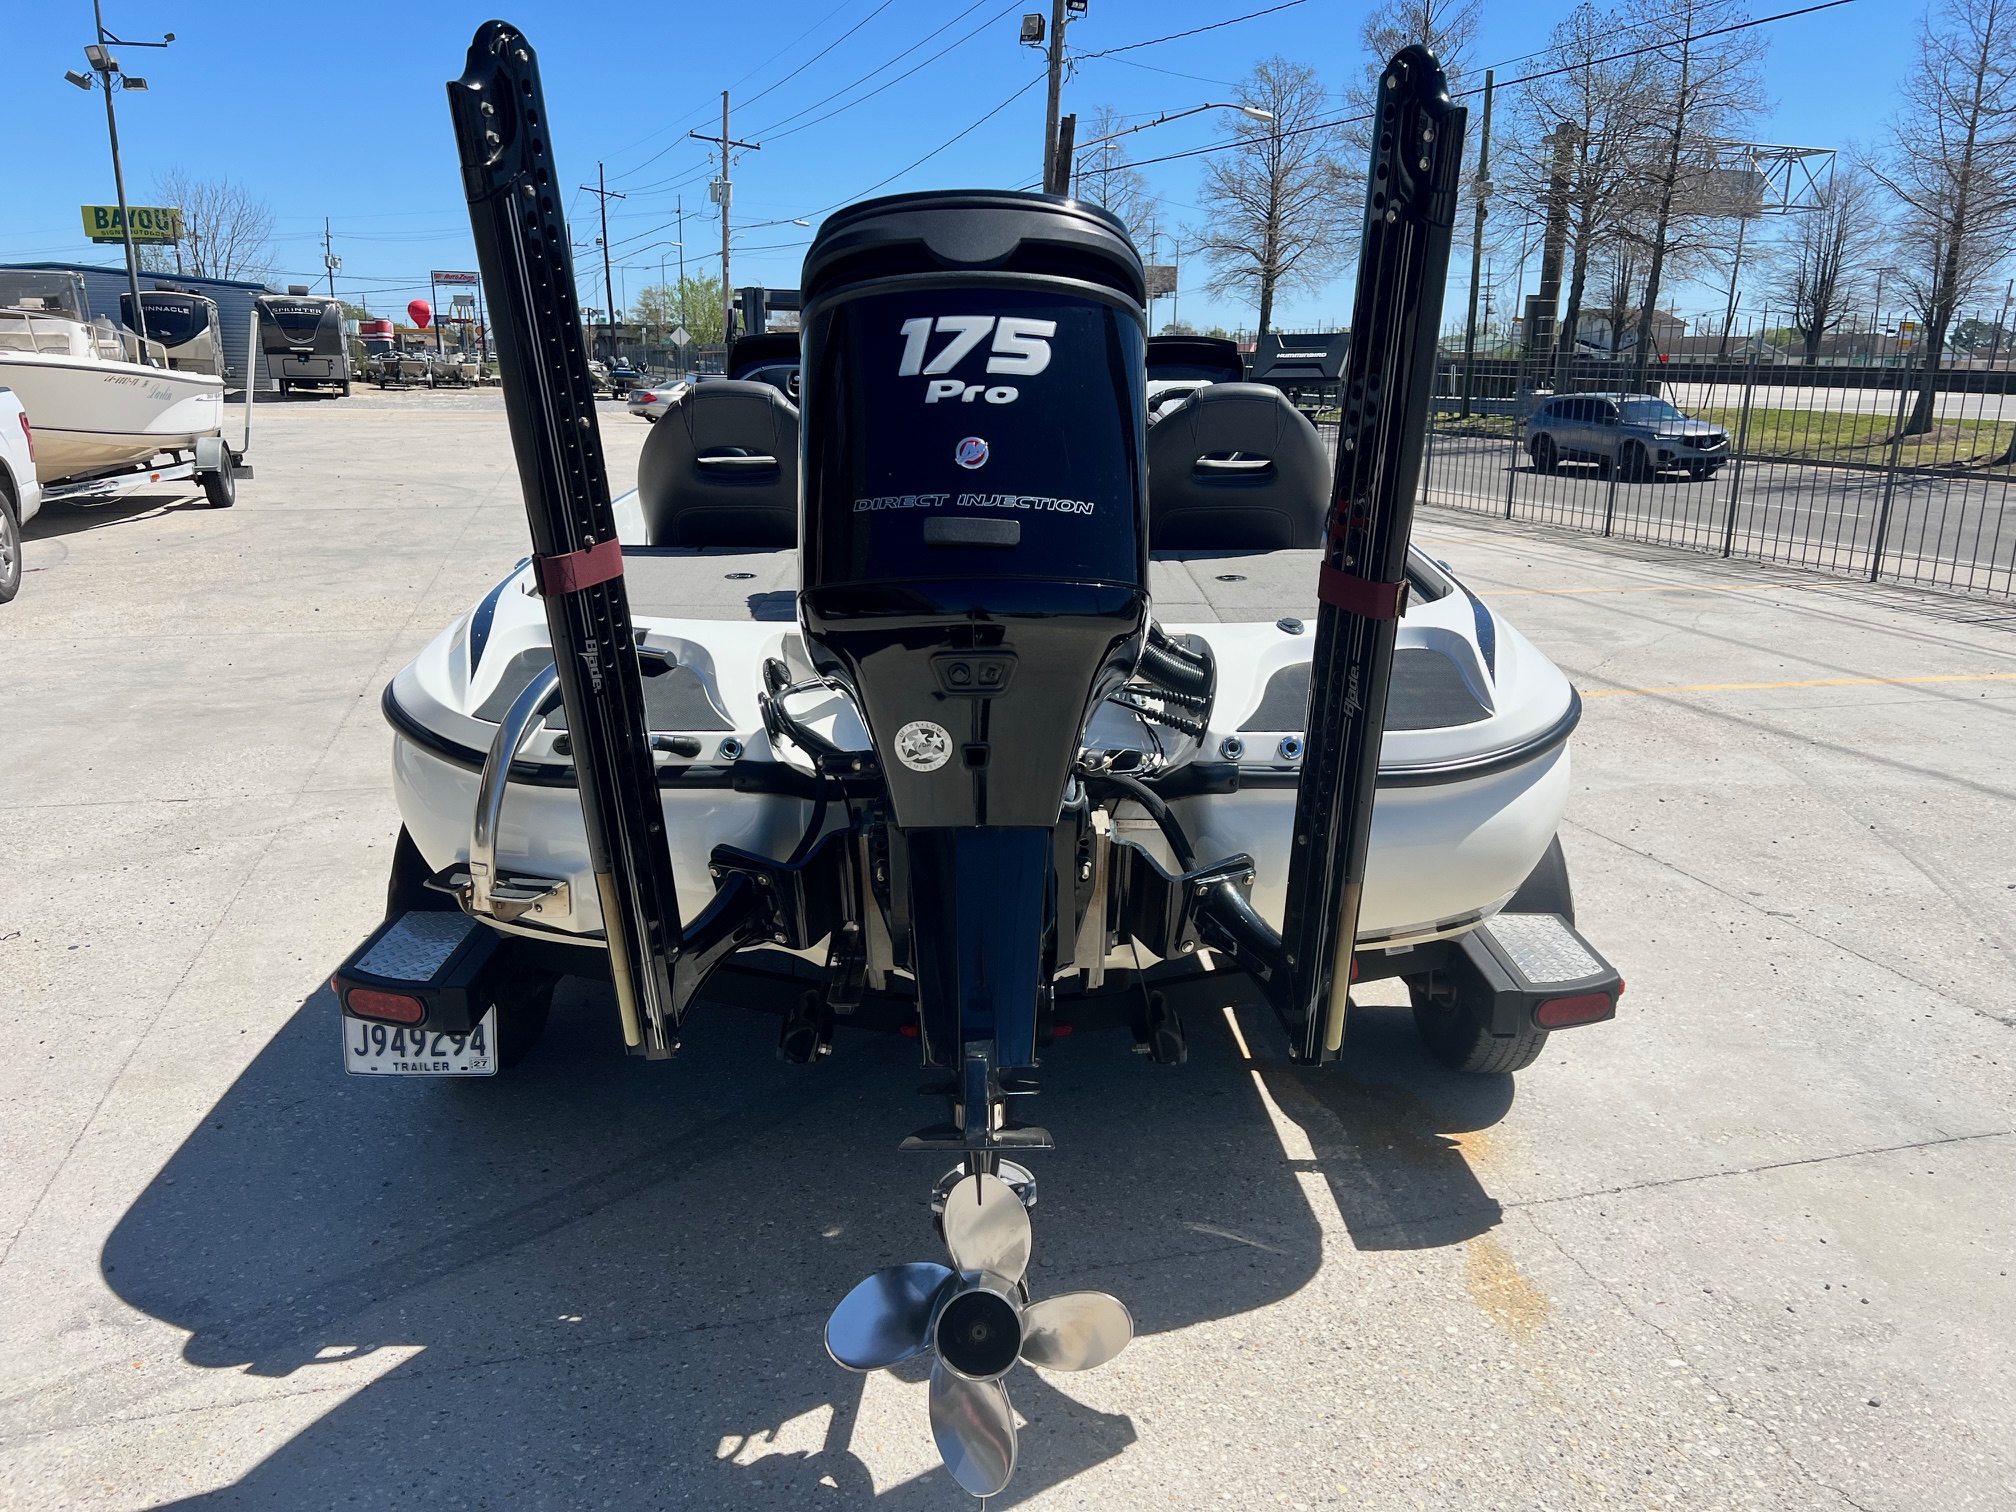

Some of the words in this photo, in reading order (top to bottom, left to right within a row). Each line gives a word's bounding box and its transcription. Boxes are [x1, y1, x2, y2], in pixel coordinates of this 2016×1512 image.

[93, 206, 169, 231] BAYOU
[271, 306, 322, 314] SPRINTER
[898, 315, 1057, 376] 175
[924, 379, 1019, 404] Pro
[853, 493, 950, 512] DIRECT
[956, 493, 1094, 515] INJECTION
[926, 722, 944, 734] LOW
[393, 1062, 450, 1072] TRAILER
